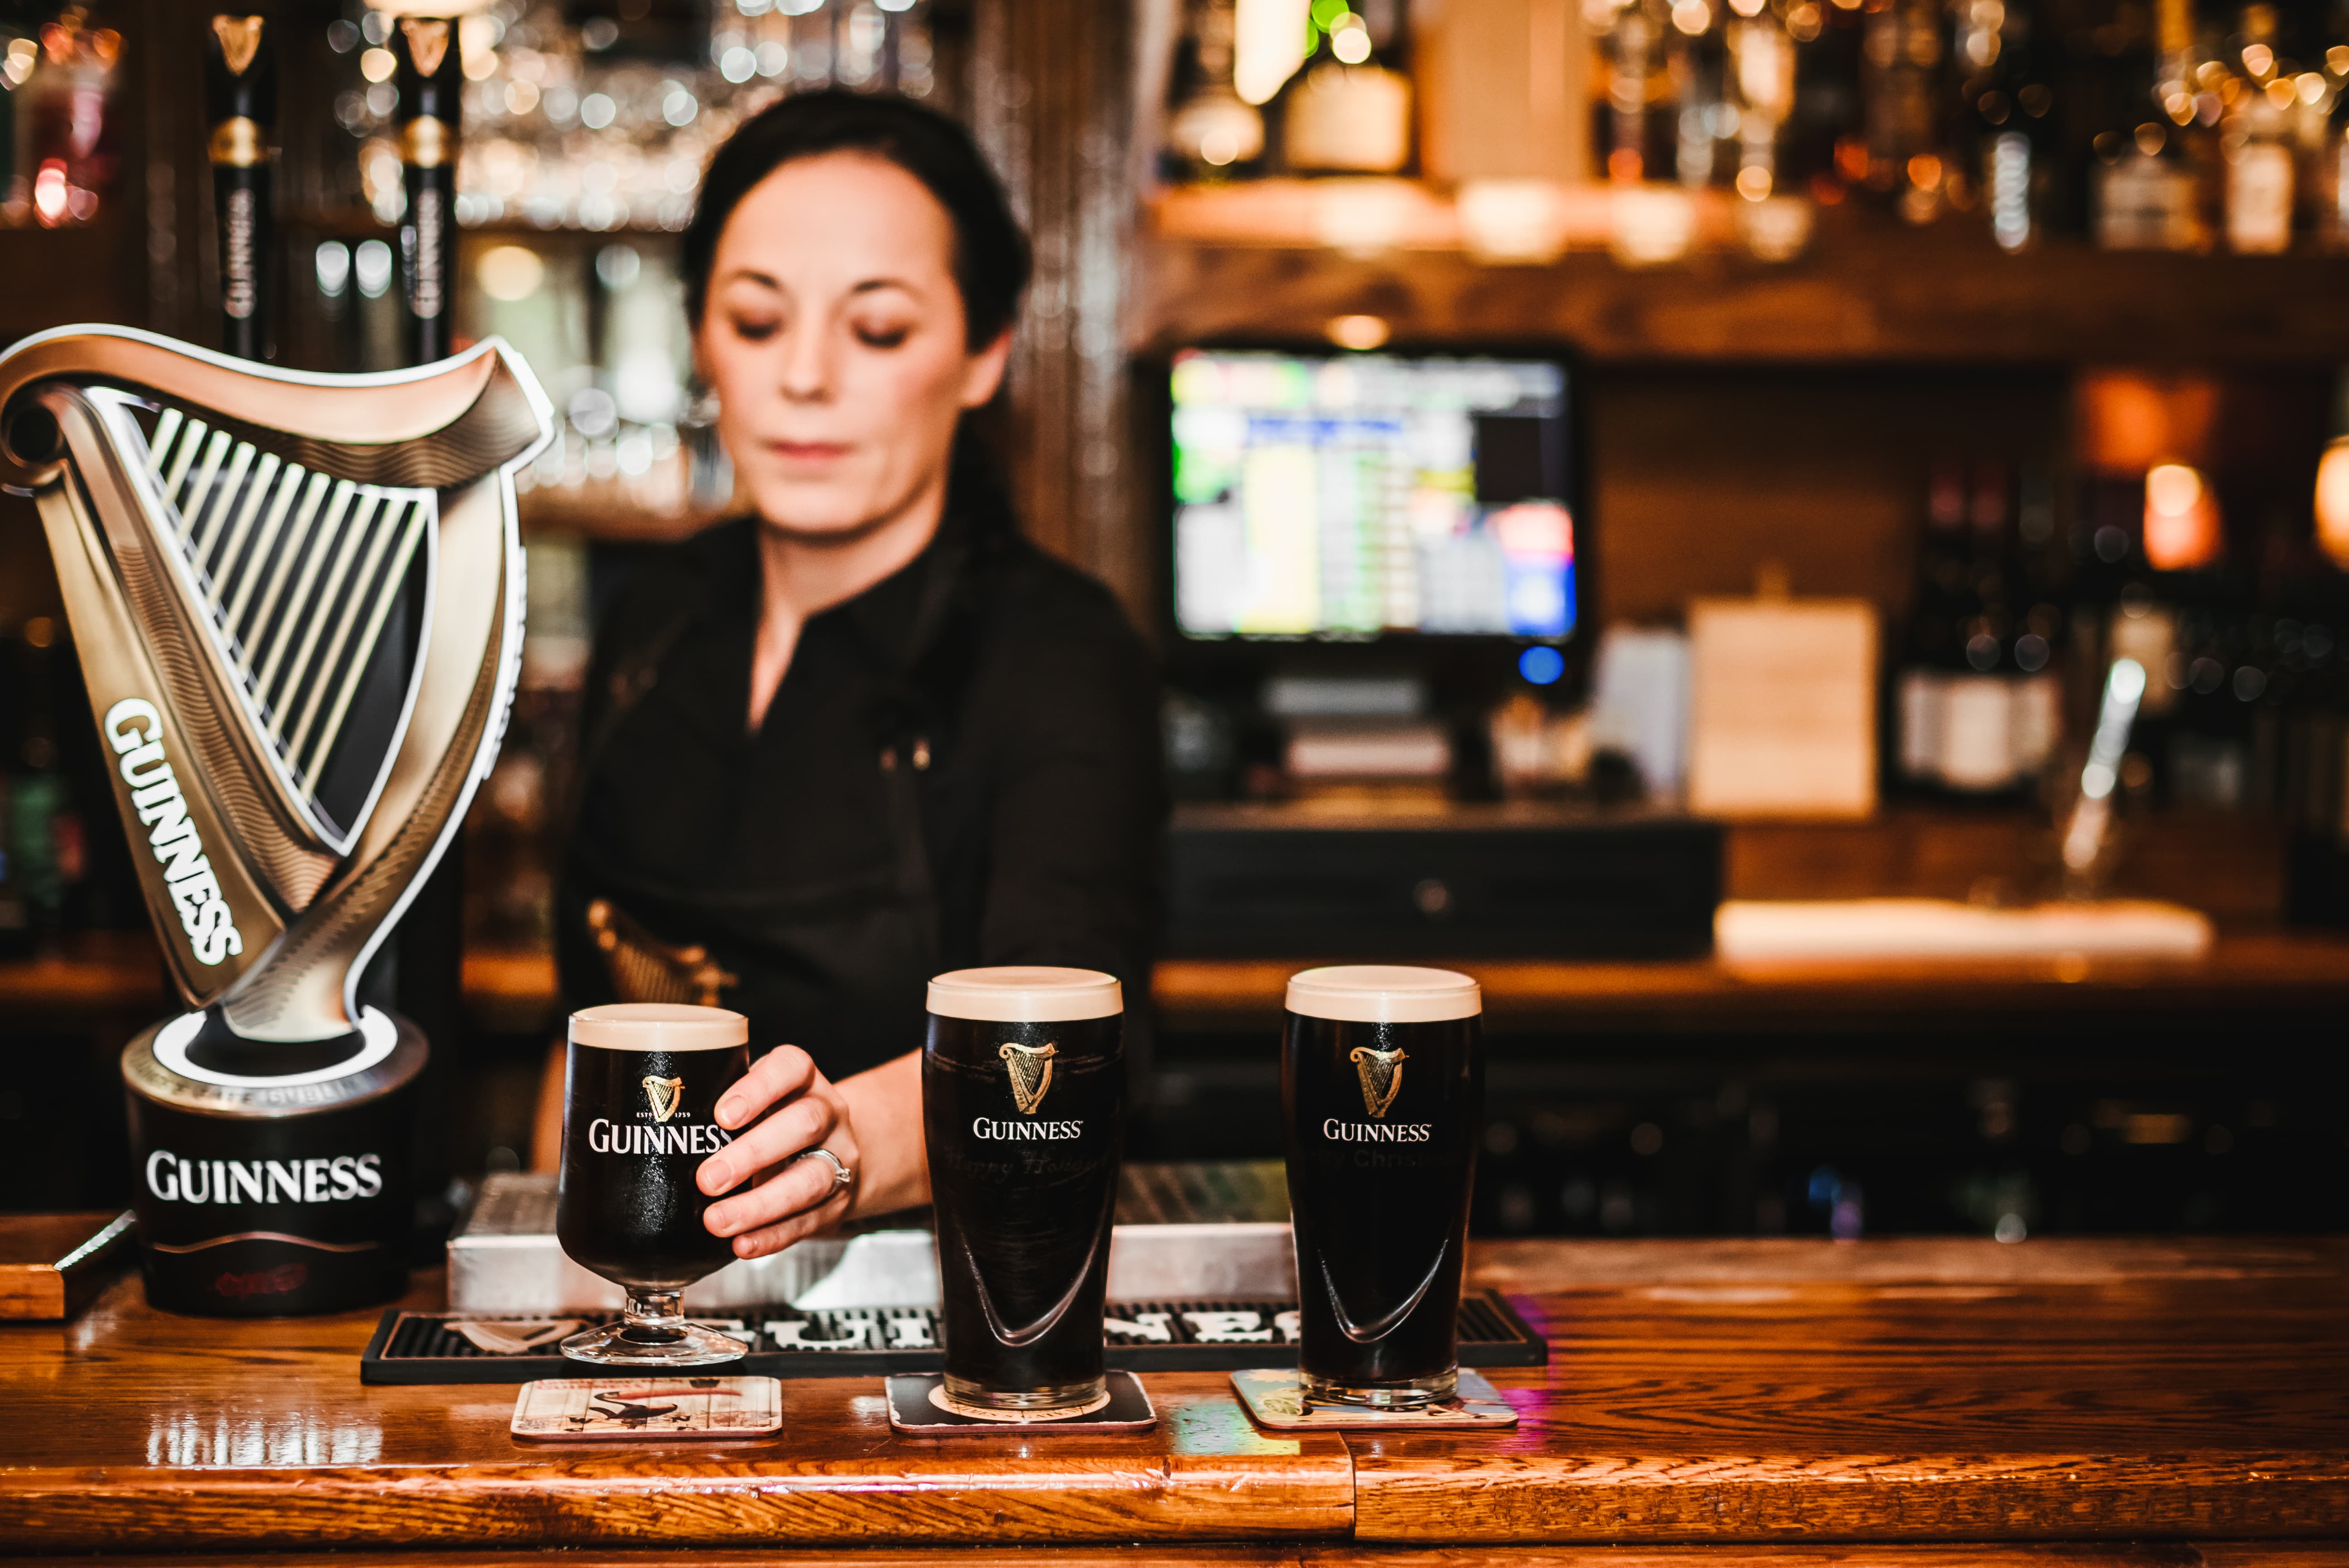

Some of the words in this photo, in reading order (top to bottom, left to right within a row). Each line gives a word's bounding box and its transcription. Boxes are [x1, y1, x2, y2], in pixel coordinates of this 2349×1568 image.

[105, 698, 244, 966] GUINNESS
[972, 1117, 1084, 1140] GUINNESS
[1323, 1118, 1432, 1142] GUINNESS
[145, 1150, 383, 1205] GUINNESS
